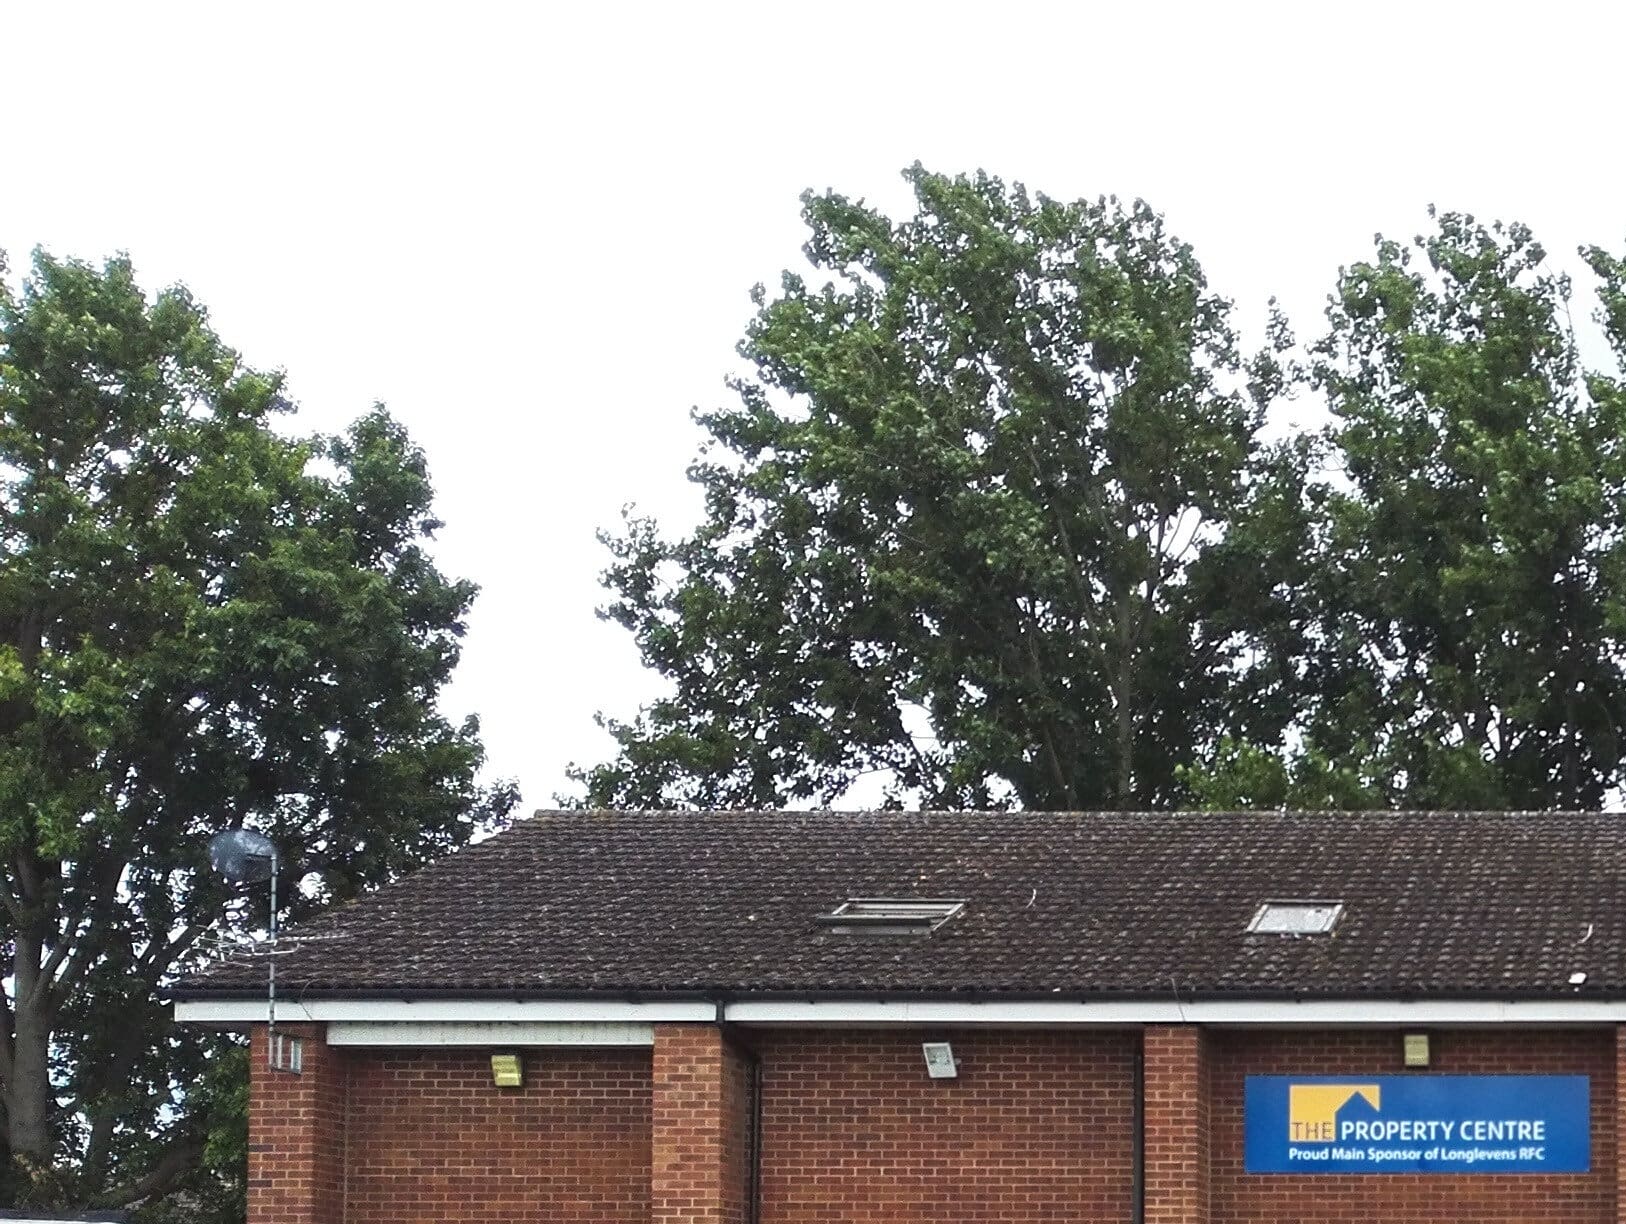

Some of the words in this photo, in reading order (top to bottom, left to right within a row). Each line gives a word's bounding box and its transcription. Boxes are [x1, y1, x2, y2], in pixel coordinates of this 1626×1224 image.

[1291, 1121, 1334, 1140] THE
[1341, 1120, 1455, 1141] PROPERTY
[1459, 1120, 1546, 1141] CENTRE
[1288, 1147, 1329, 1160] Proud
[1331, 1147, 1365, 1160] Main
[1367, 1147, 1423, 1164] Sponsor
[1424, 1147, 1438, 1160] of
[1441, 1147, 1518, 1164] Longlevens
[1519, 1147, 1546, 1160] RFC
